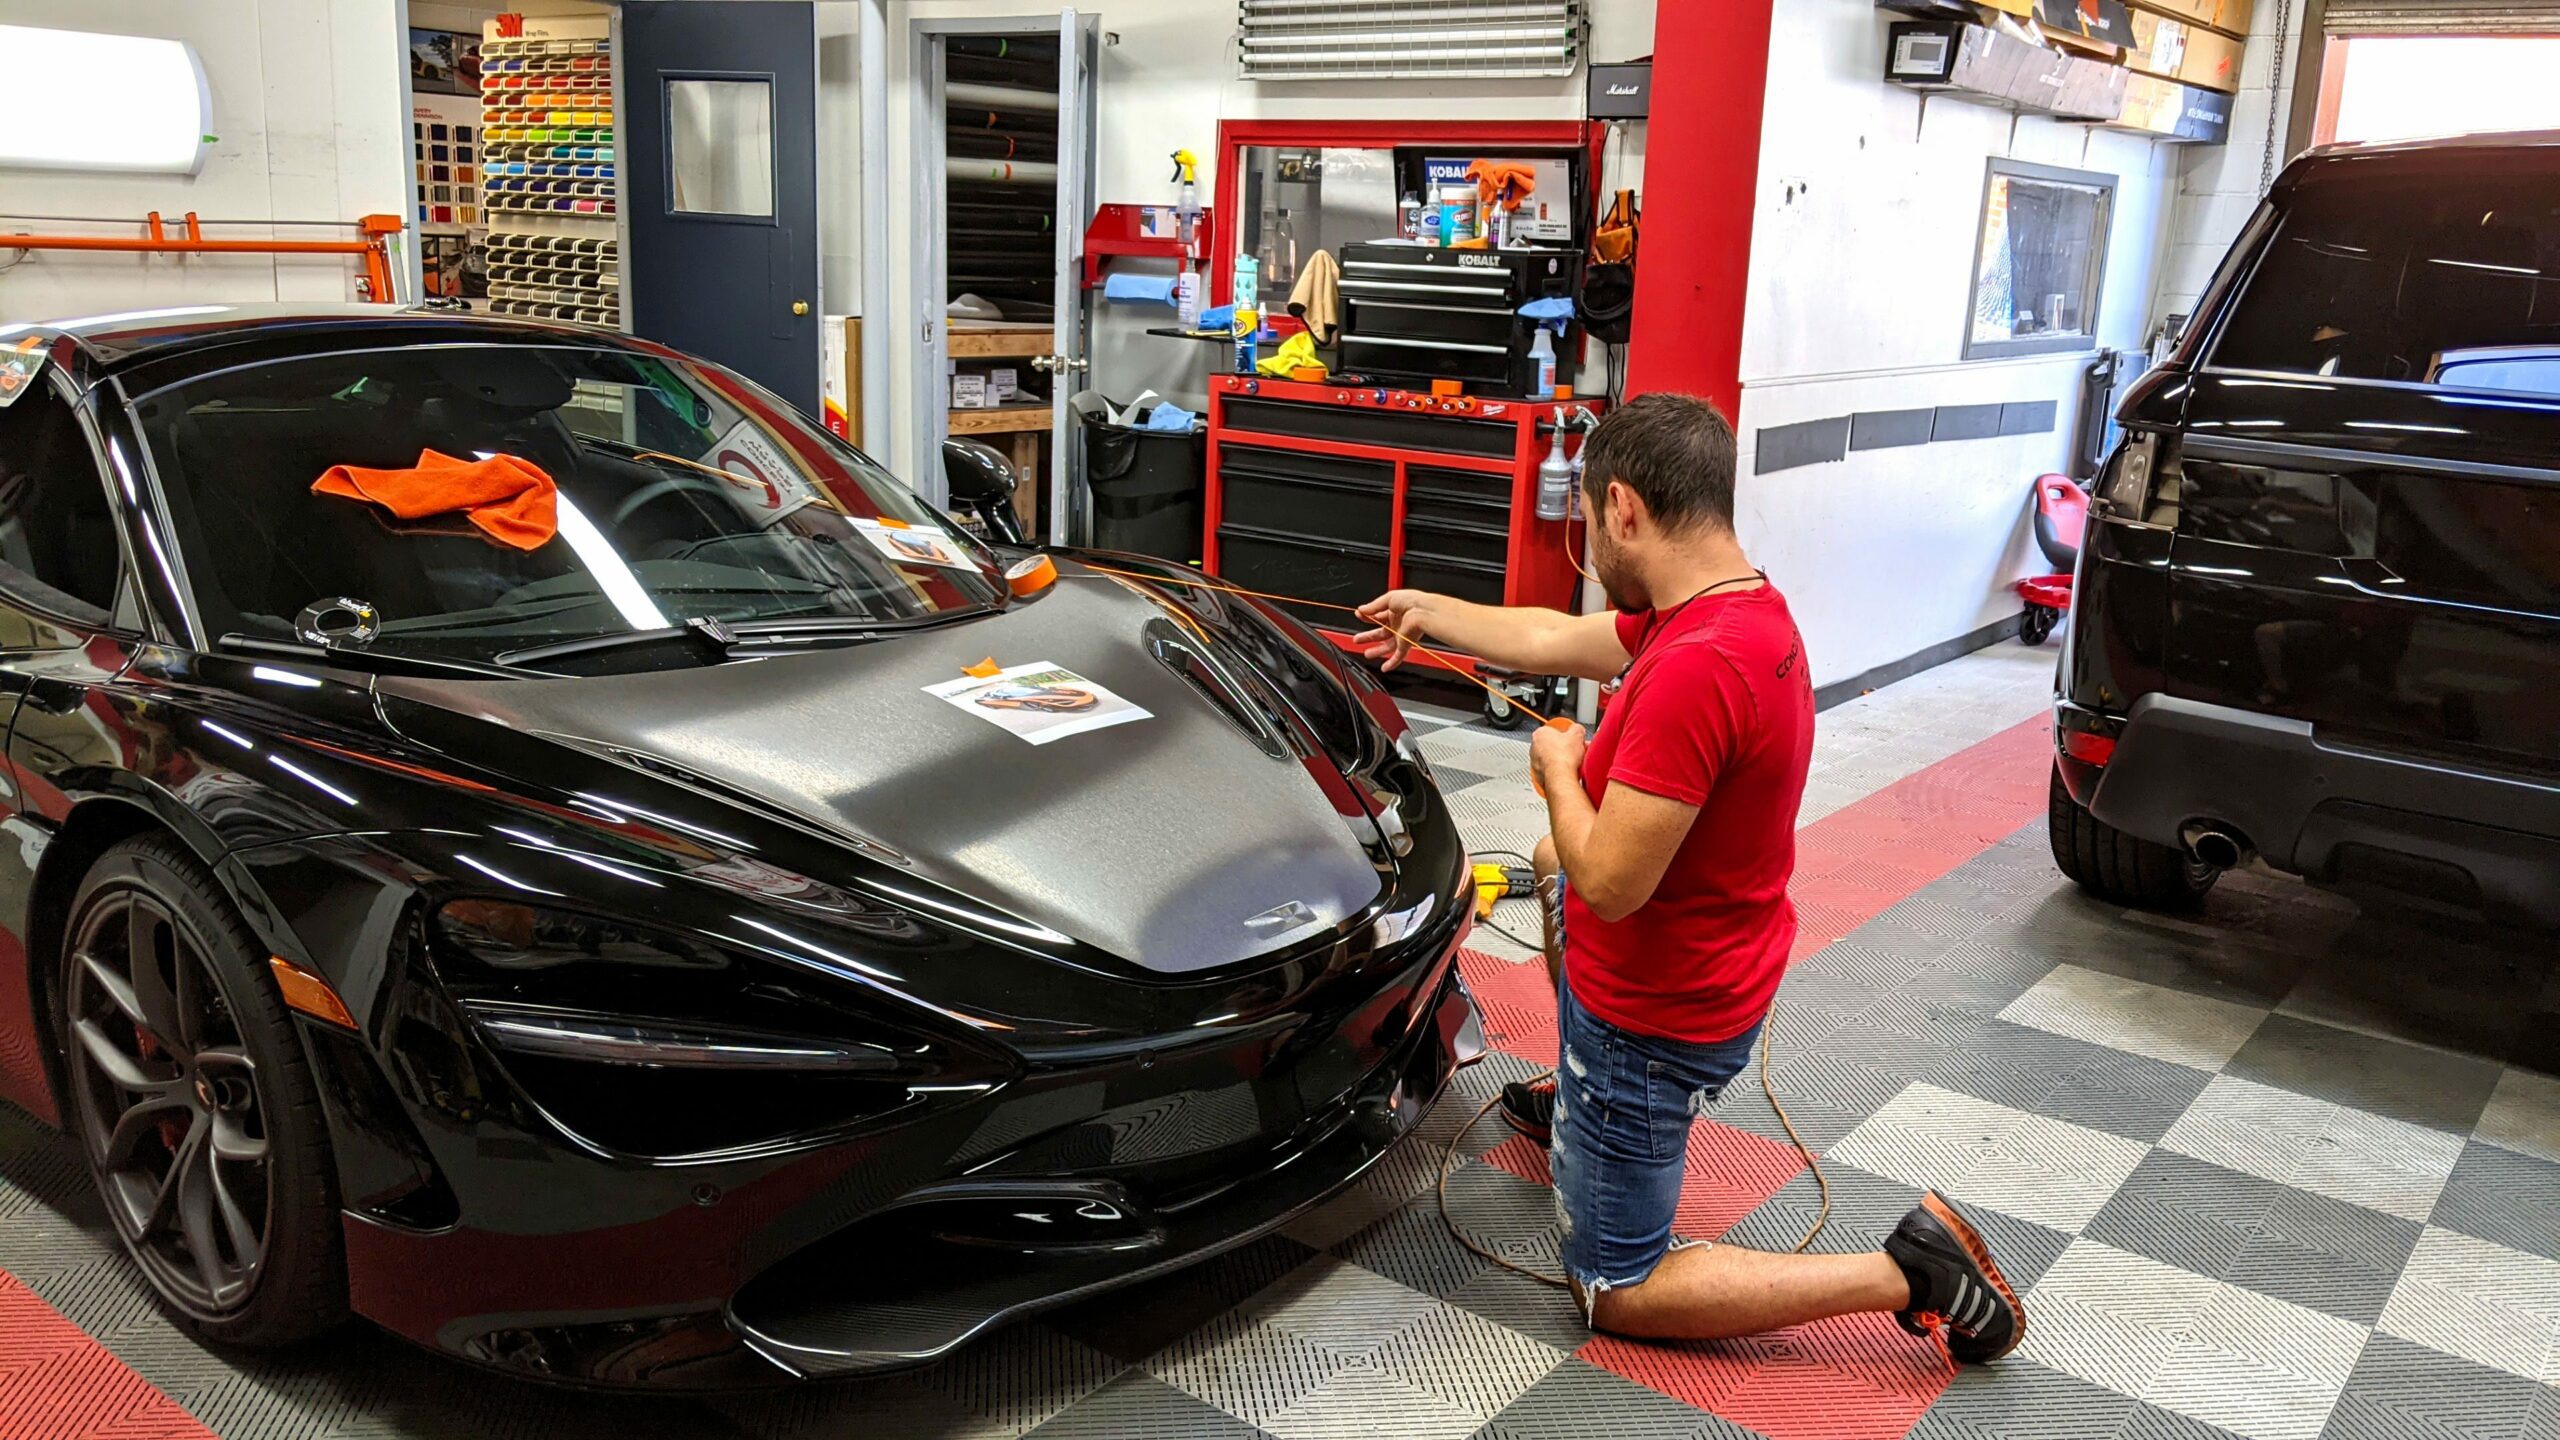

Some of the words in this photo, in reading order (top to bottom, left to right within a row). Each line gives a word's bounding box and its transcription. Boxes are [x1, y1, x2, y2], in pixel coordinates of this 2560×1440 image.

[496, 13, 522, 37] 3M
[1606, 83, 1639, 95] Marshall
[1428, 166, 1469, 178] KOBAL
[1458, 254, 1500, 266] KOBALT
